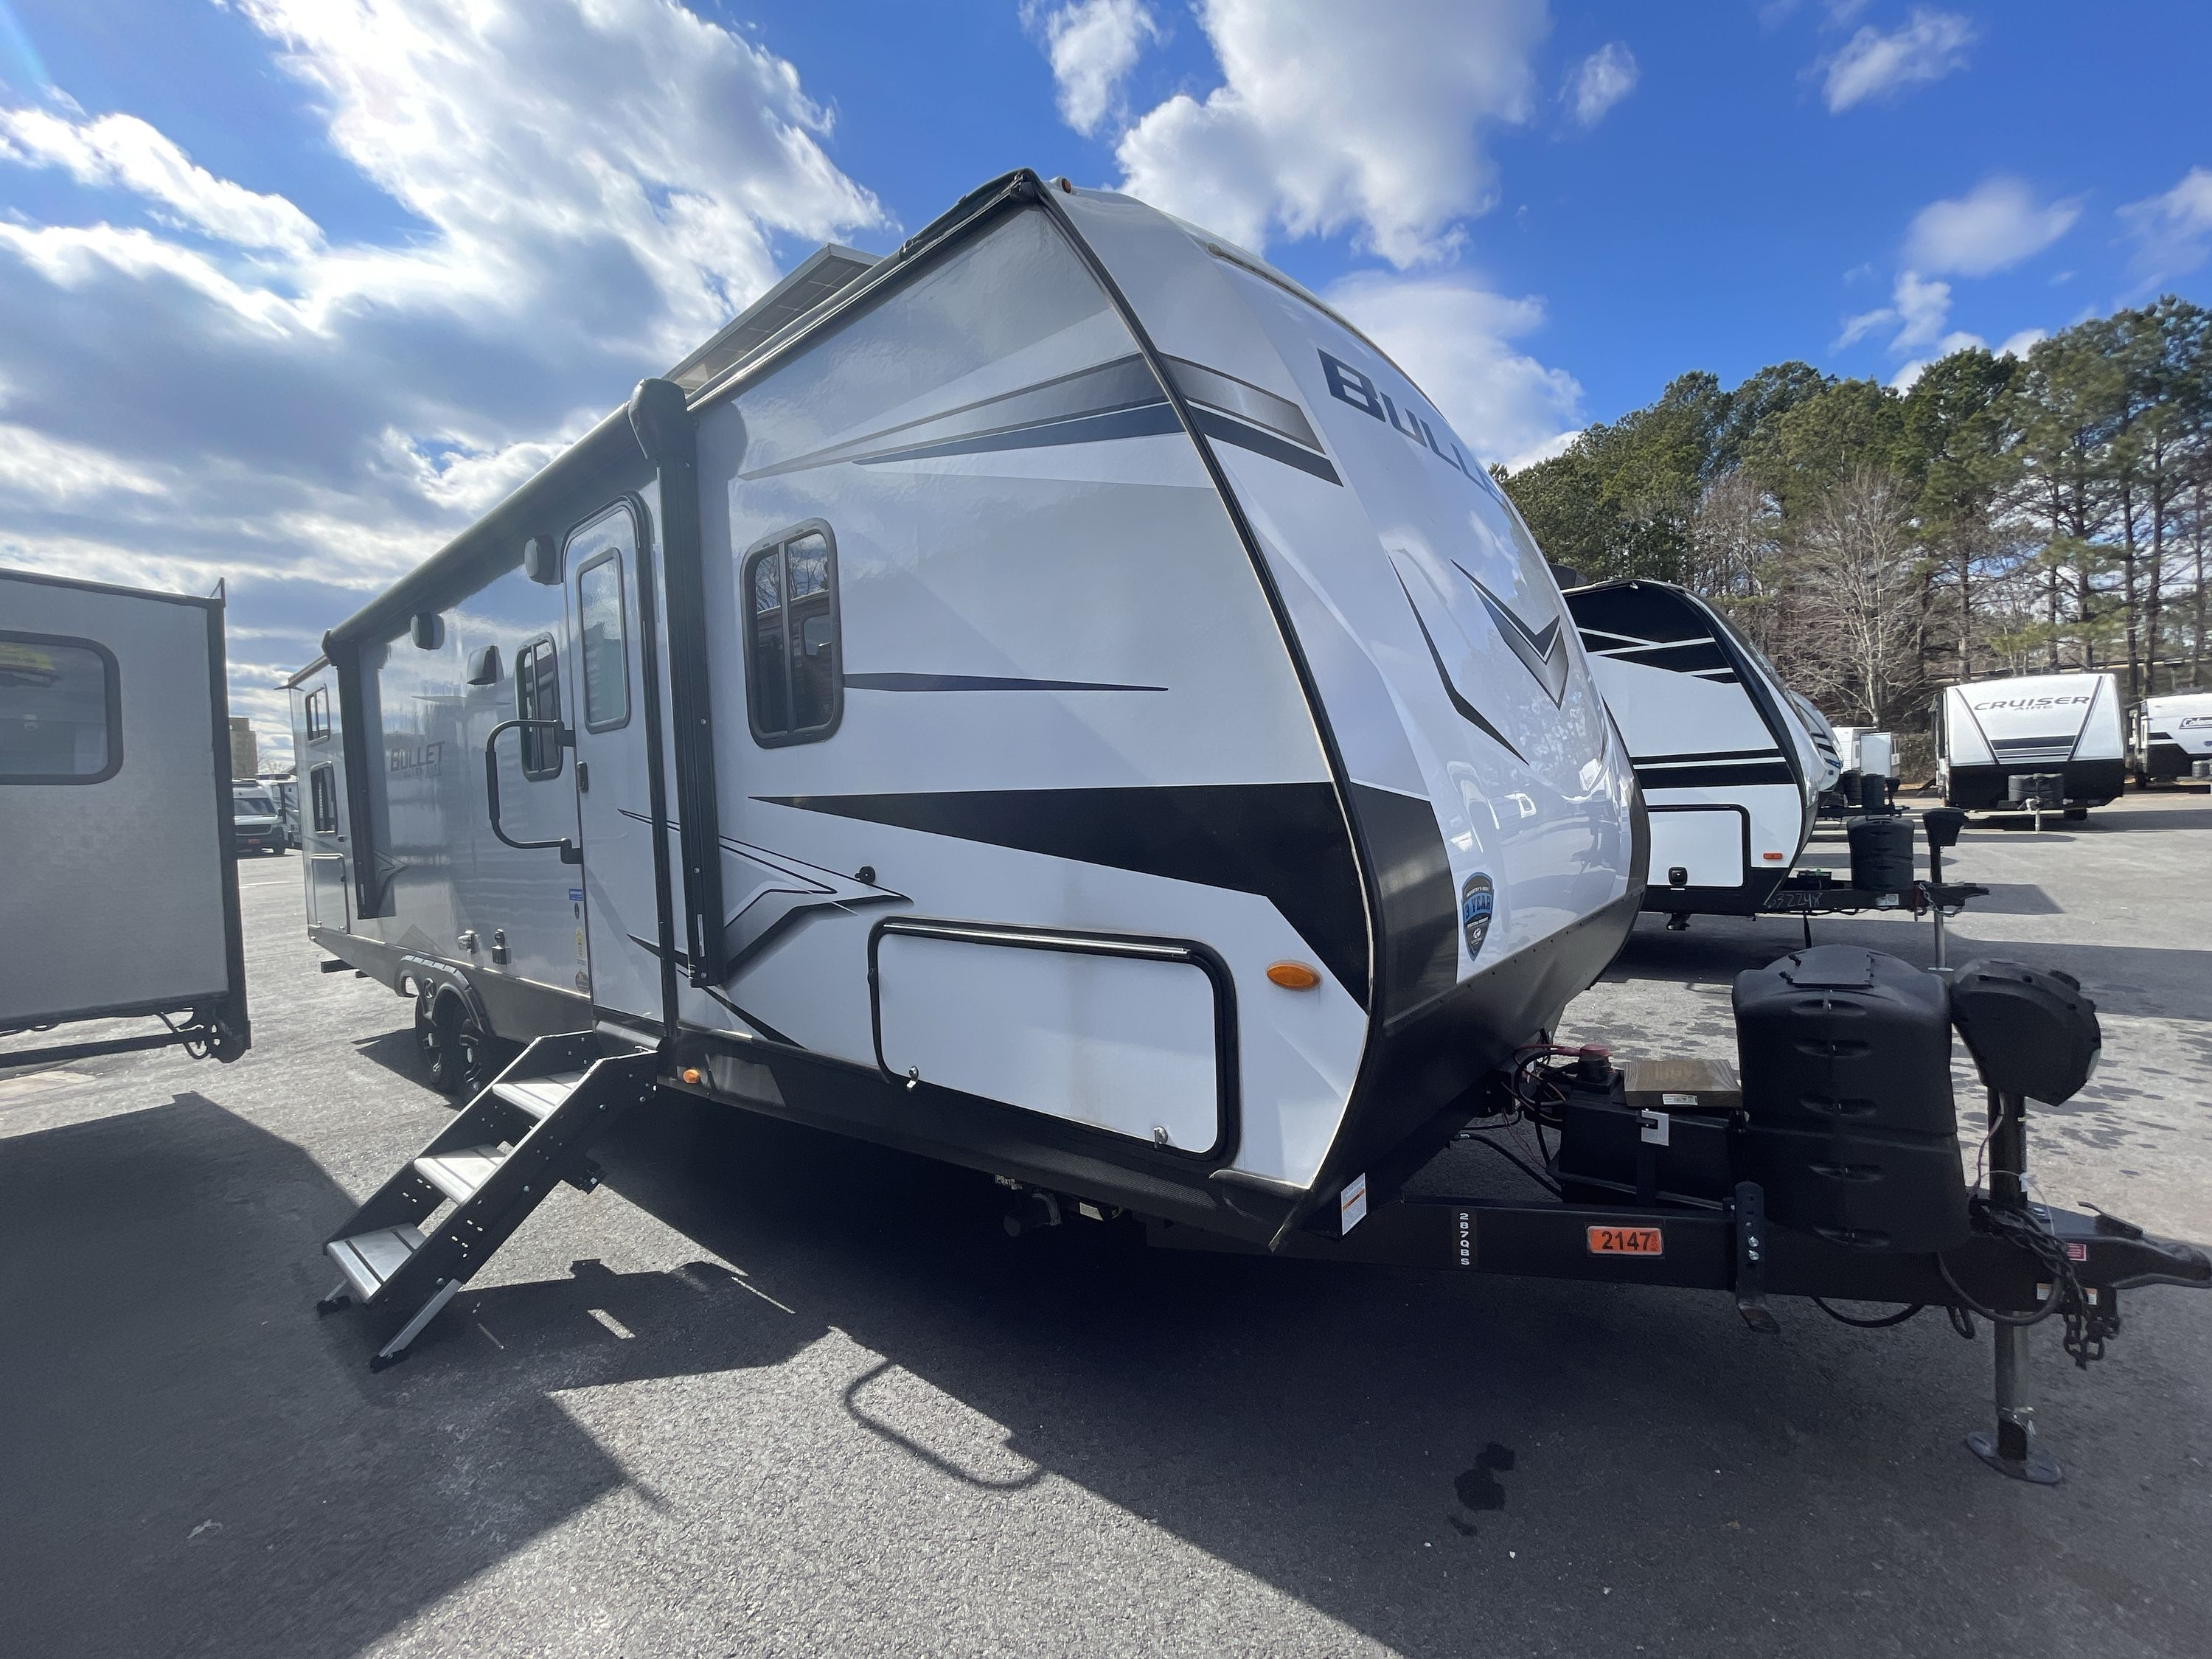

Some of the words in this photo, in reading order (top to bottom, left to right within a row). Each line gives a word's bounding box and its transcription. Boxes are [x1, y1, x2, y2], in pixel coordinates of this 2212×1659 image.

[1974, 696, 2090, 711] CRUISER
[390, 740, 446, 772] BULLET
[1464, 902, 1470, 920] 3
[1471, 894, 1491, 913] YEAR
[1601, 1231, 1651, 1251] 2147
